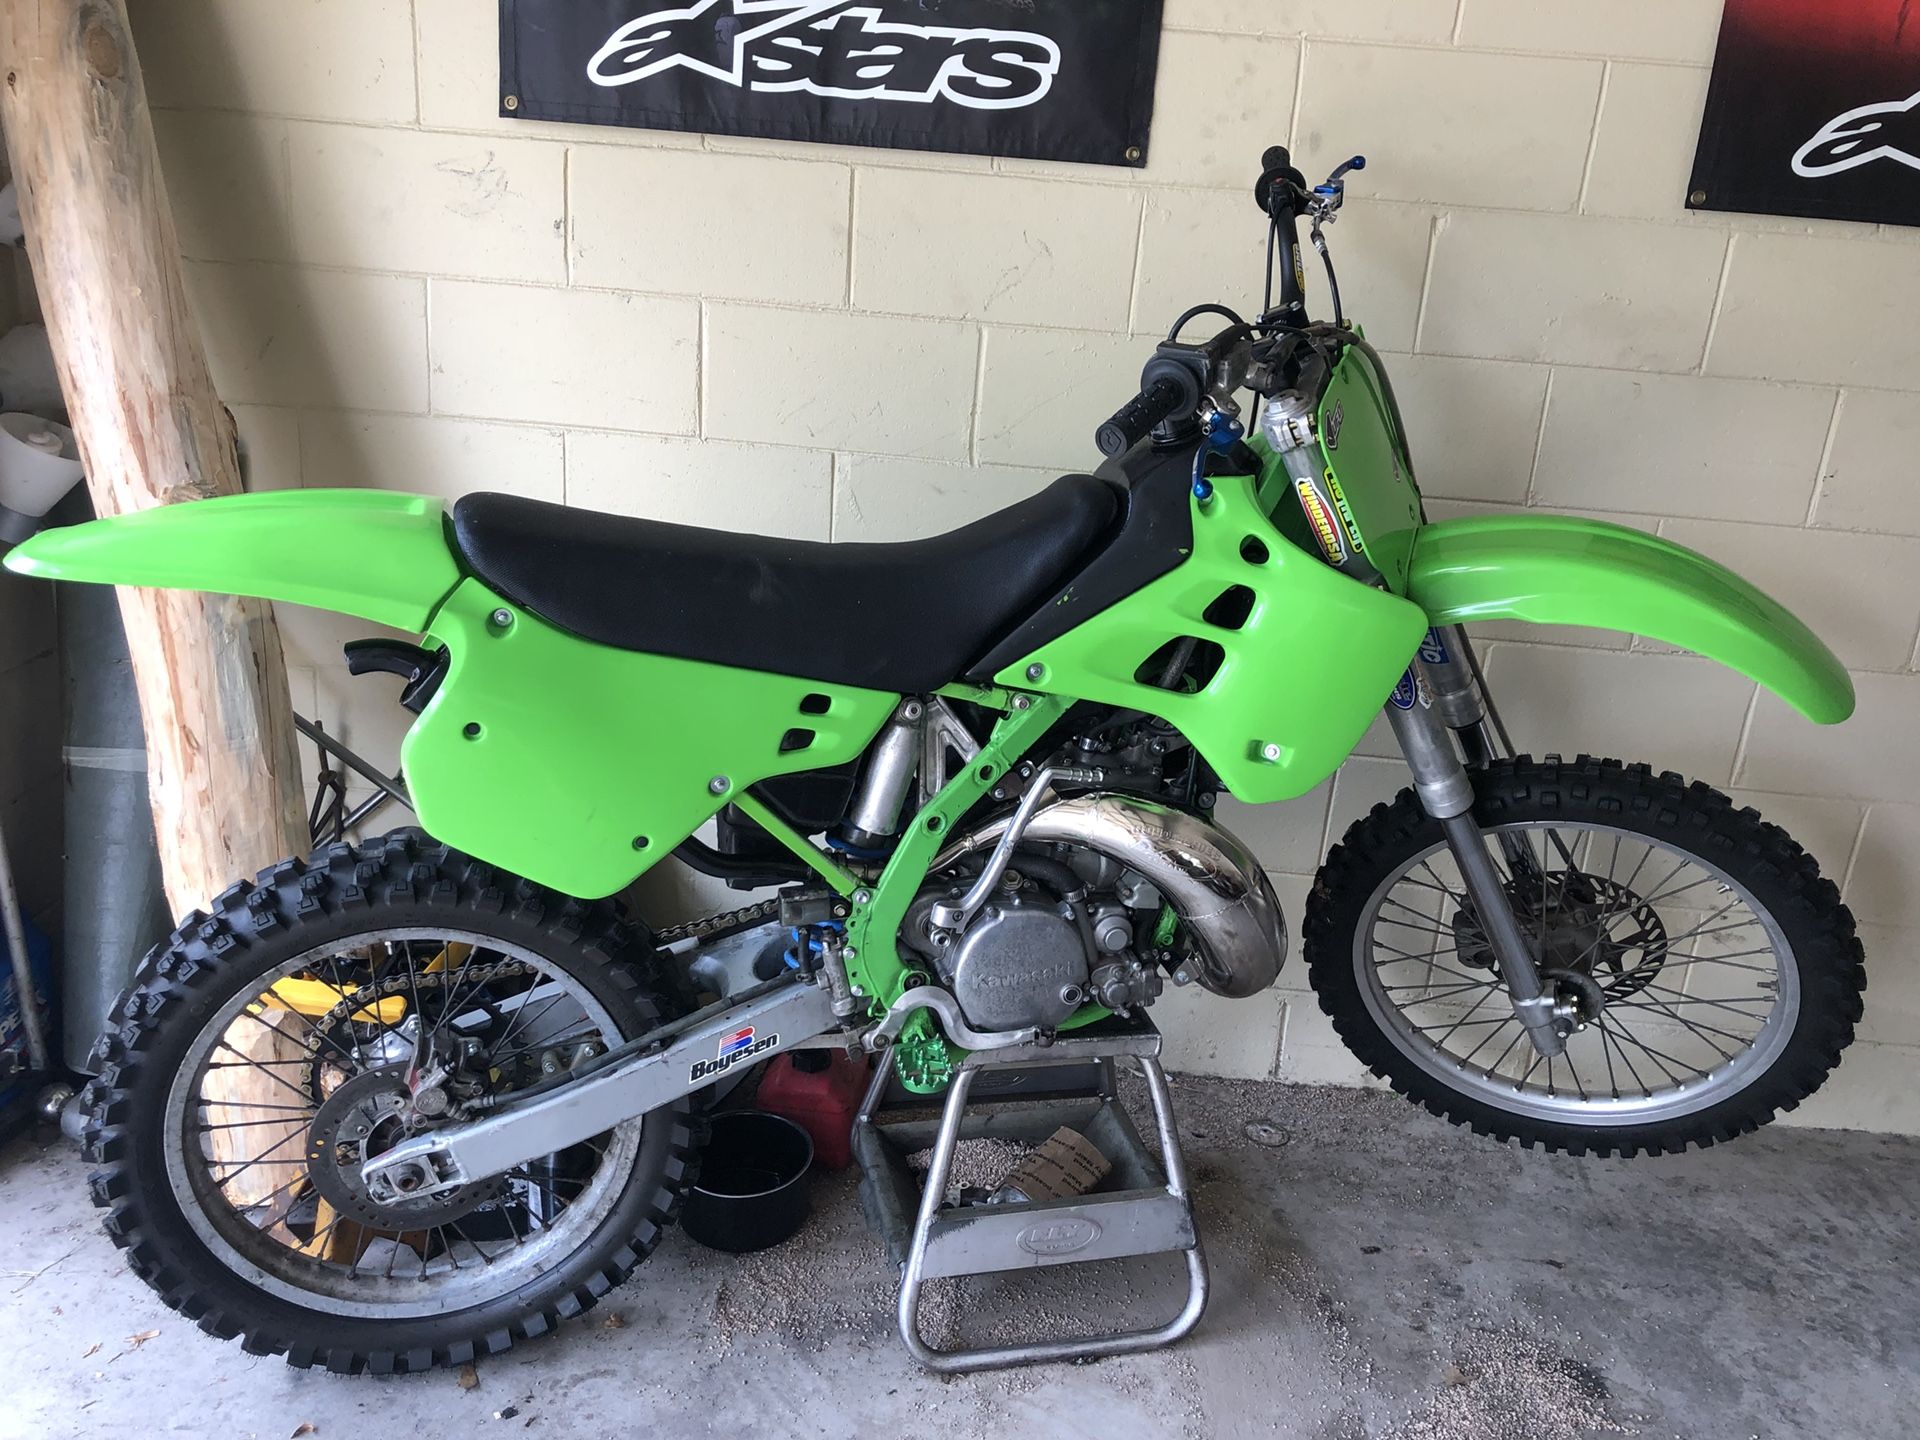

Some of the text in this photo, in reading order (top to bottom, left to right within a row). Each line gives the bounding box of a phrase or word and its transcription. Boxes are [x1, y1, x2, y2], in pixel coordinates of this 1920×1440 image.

[1299, 481, 1344, 563] WINDEROSA
[972, 961, 1073, 989] Kawasaki
[691, 1034, 778, 1081] Boyesen
